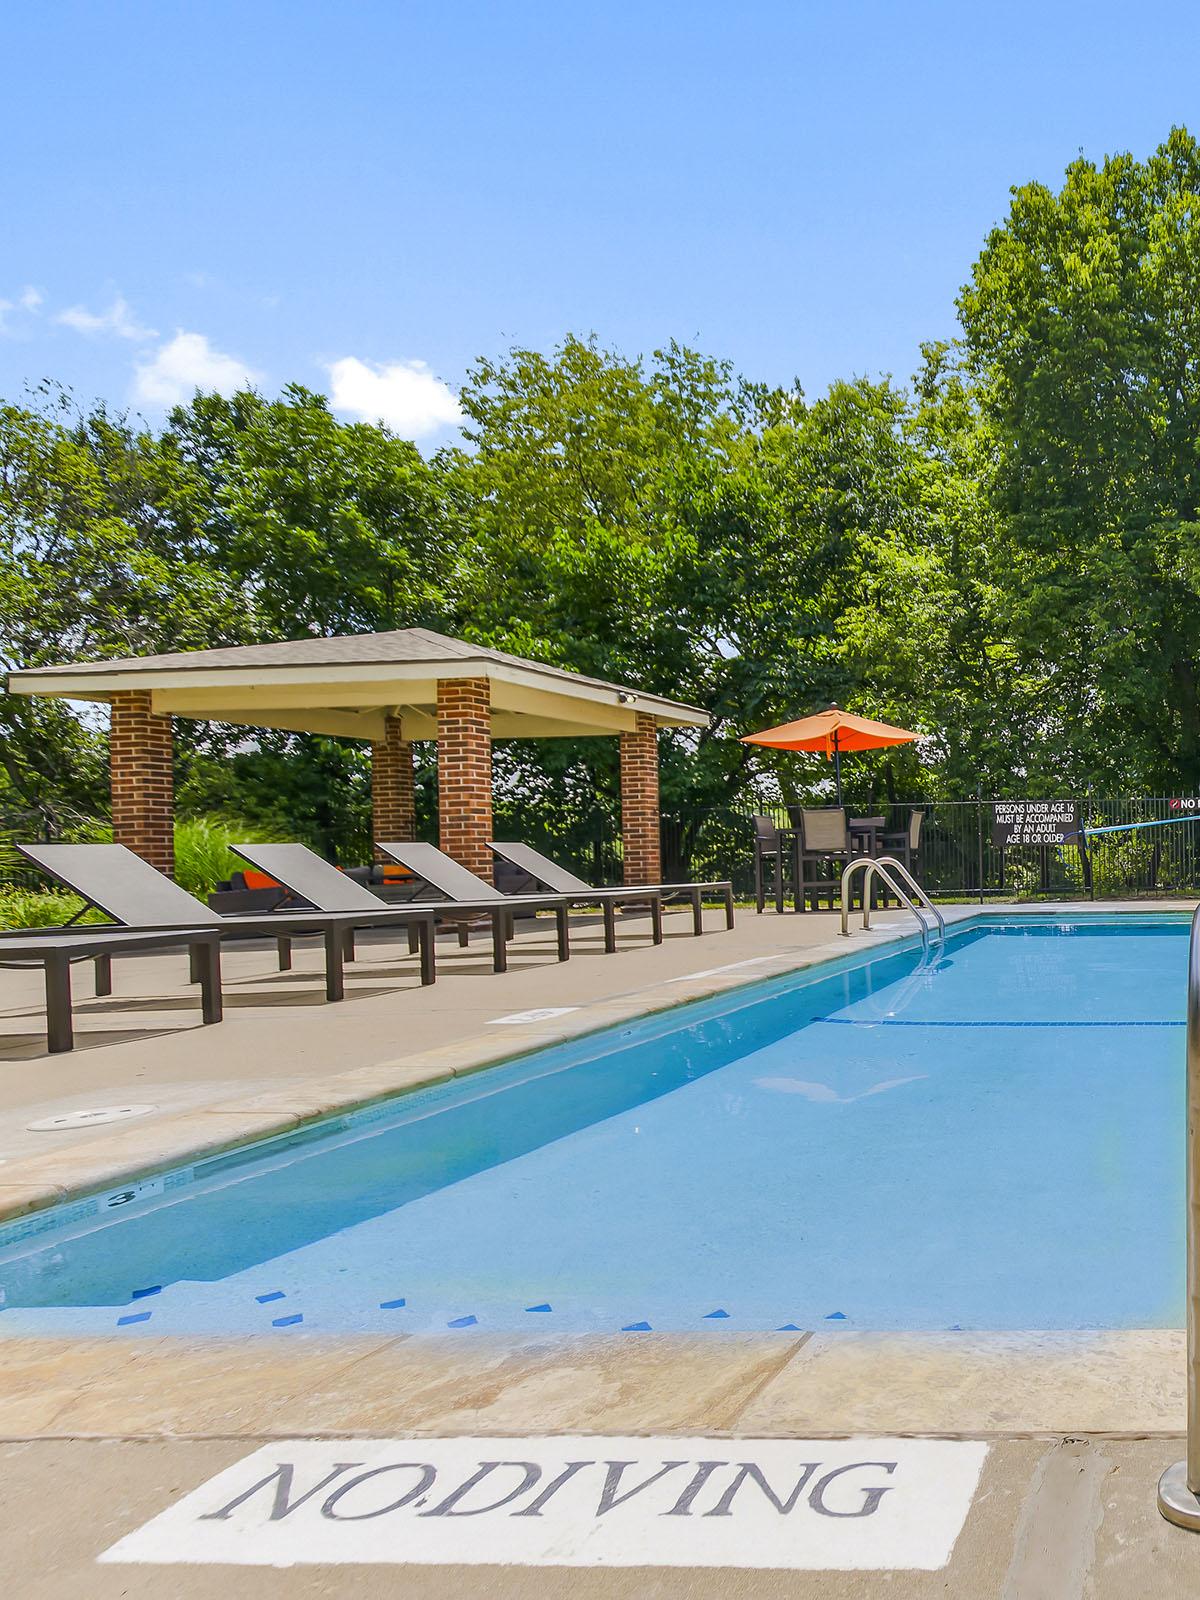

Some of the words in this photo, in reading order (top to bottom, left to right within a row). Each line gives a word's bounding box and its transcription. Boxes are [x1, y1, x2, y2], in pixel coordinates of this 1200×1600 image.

[995, 804, 1025, 814] PERSONS
[1026, 804, 1049, 813] UNDER
[1051, 803, 1065, 813] AGE
[1067, 803, 1075, 813] 16
[1180, 799, 1195, 809] NO
[996, 814, 1014, 824] MUST
[1016, 814, 1024, 823] BE
[1025, 813, 1074, 823] ACCOMPANIED
[1014, 824, 1022, 833] BY
[1023, 824, 1034, 833] AN
[1036, 824, 1056, 833] ADULT
[1006, 834, 1020, 844] AGE
[1023, 834, 1030, 843] 18
[1031, 834, 1042, 843] OR
[107, 1190, 137, 1207] 3
